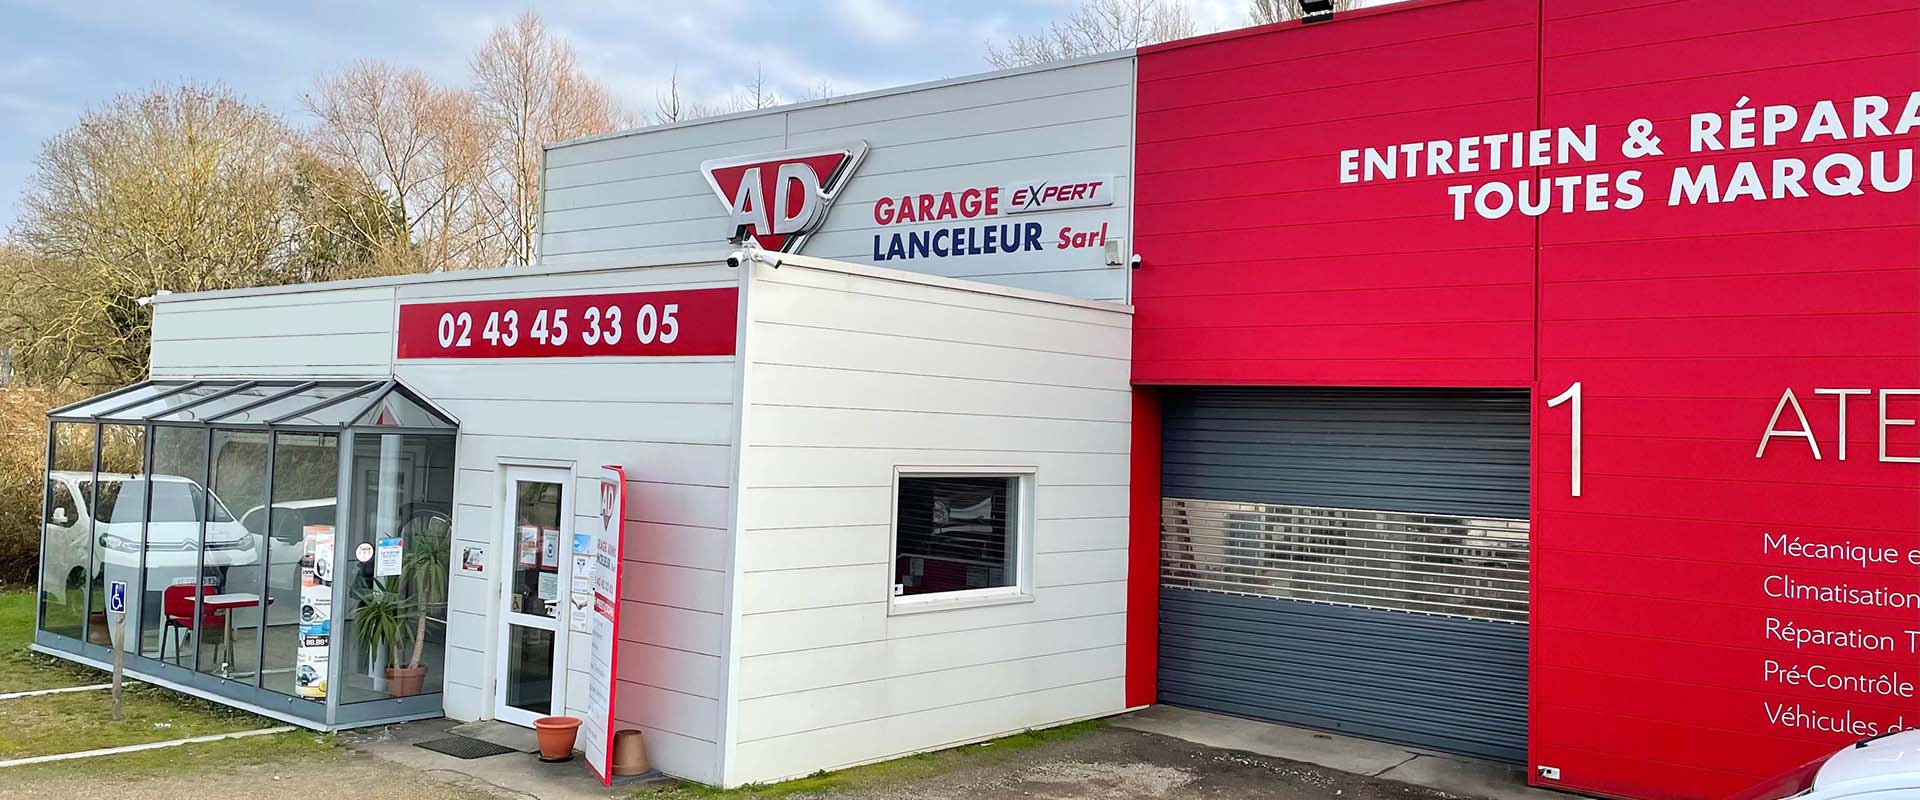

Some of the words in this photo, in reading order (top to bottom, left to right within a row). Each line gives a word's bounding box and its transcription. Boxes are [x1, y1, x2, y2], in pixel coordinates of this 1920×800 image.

[1340, 125, 1597, 183] ENTRETIEN
[1622, 119, 1664, 158] &
[727, 162, 826, 240] AD
[1448, 170, 1644, 220] TOUTES
[1668, 148, 1913, 206] MARQU
[874, 187, 999, 225] GARAGE
[873, 221, 1043, 261] LANCELEUR
[1057, 222, 1108, 249] Sarl
[438, 312, 473, 349] 02
[482, 309, 519, 347] 43
[530, 308, 568, 346] 45
[581, 305, 622, 346] 33
[636, 303, 679, 345] 05
[1547, 382, 1582, 497] 1
[1756, 387, 1920, 463] ATE
[1764, 532, 1899, 569] Mécanique
[1764, 574, 1920, 609] Climatisation
[1766, 617, 1894, 652] Réparation
[1765, 659, 1914, 698] Pré-Contrôle
[1764, 701, 1879, 737] Véhicules
[1887, 715, 1914, 733] d
